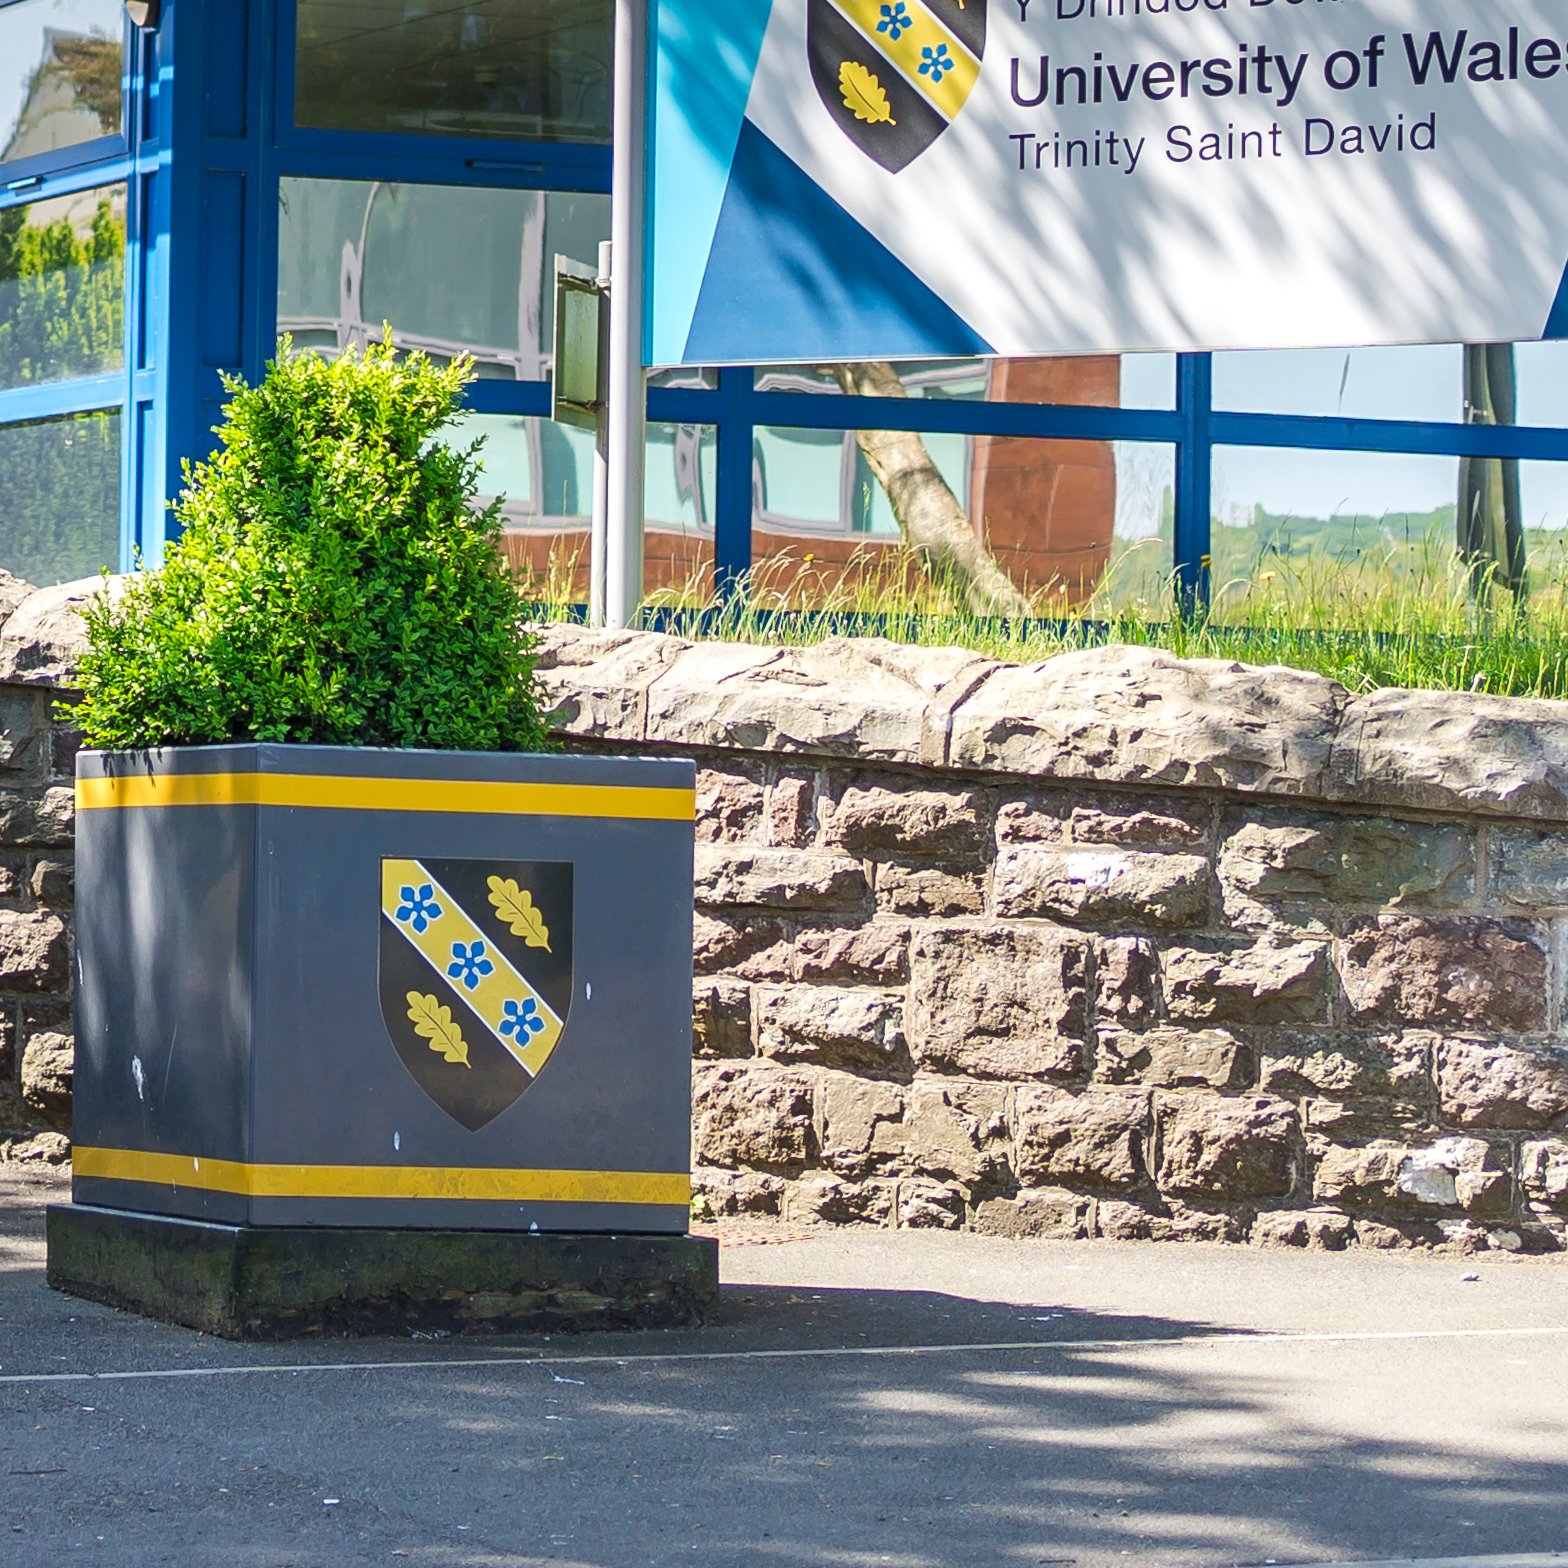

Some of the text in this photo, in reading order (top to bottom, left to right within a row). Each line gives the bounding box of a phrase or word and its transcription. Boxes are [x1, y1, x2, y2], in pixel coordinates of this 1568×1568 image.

[1010, 26, 1568, 108] University of Wale
[1008, 112, 1437, 175] Trinity Saint David
